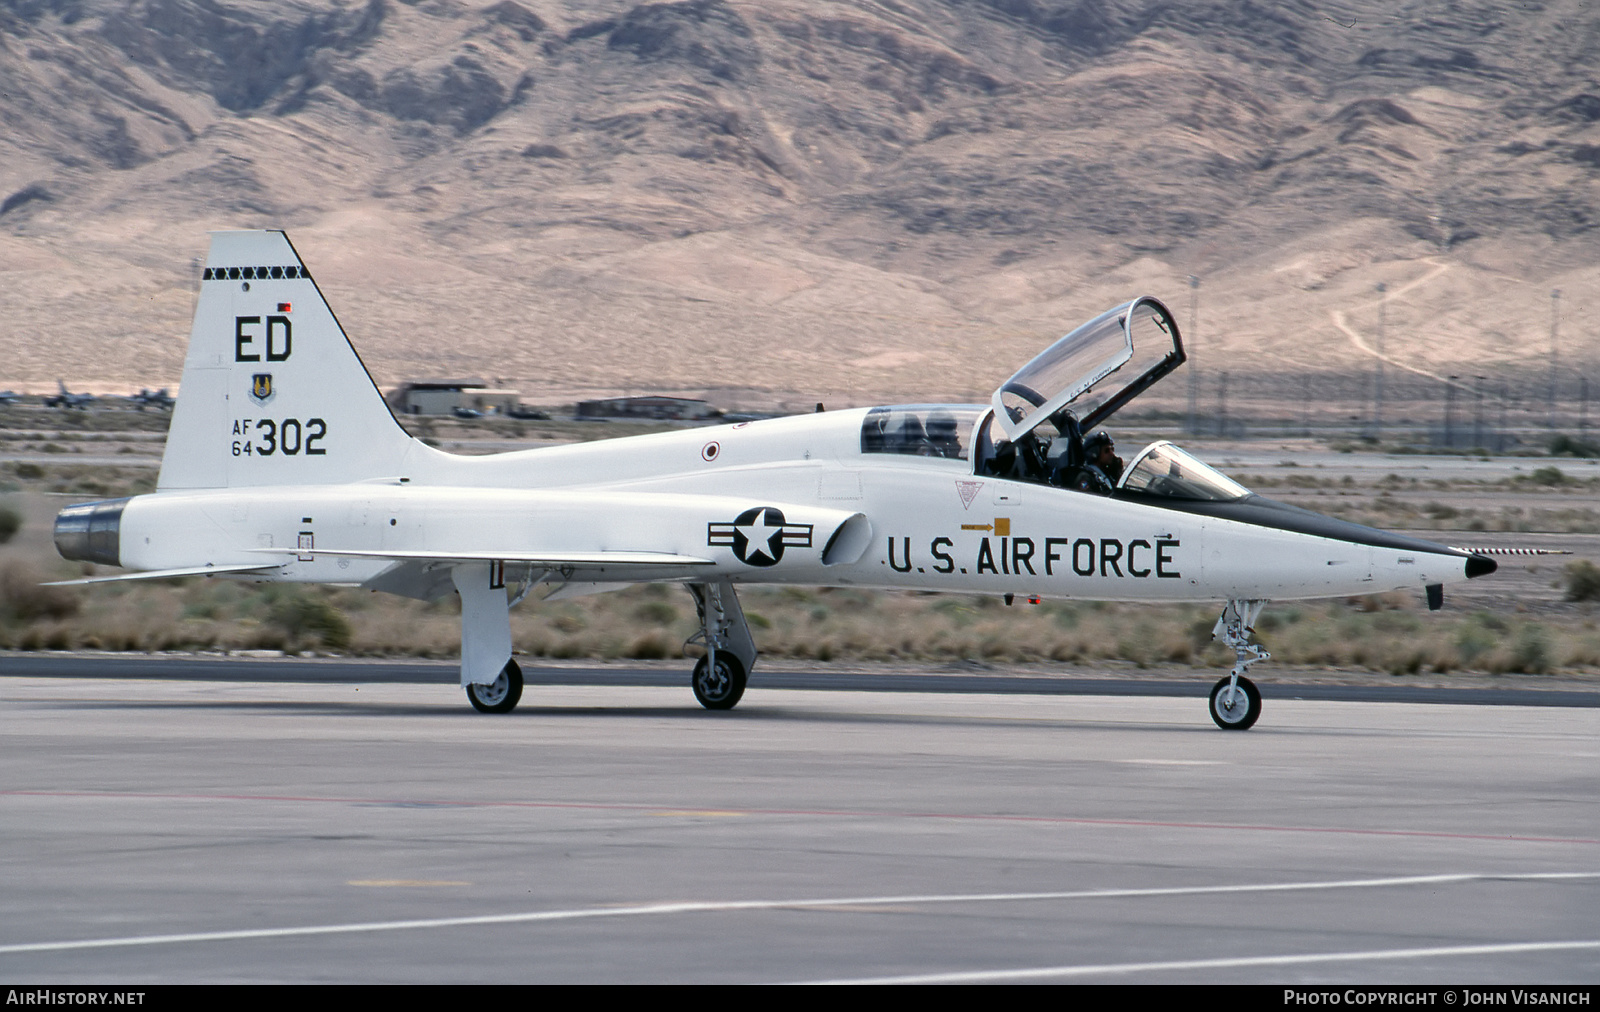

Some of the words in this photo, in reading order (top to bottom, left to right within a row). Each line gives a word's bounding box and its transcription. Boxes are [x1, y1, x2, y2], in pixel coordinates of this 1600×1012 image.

[235, 315, 292, 362] ED
[232, 419, 252, 435] AF
[256, 418, 327, 456] 302
[232, 440, 252, 456] 64
[888, 536, 968, 574] U.S.
[977, 537, 1037, 575] AIR
[1045, 537, 1182, 578] FORCE
